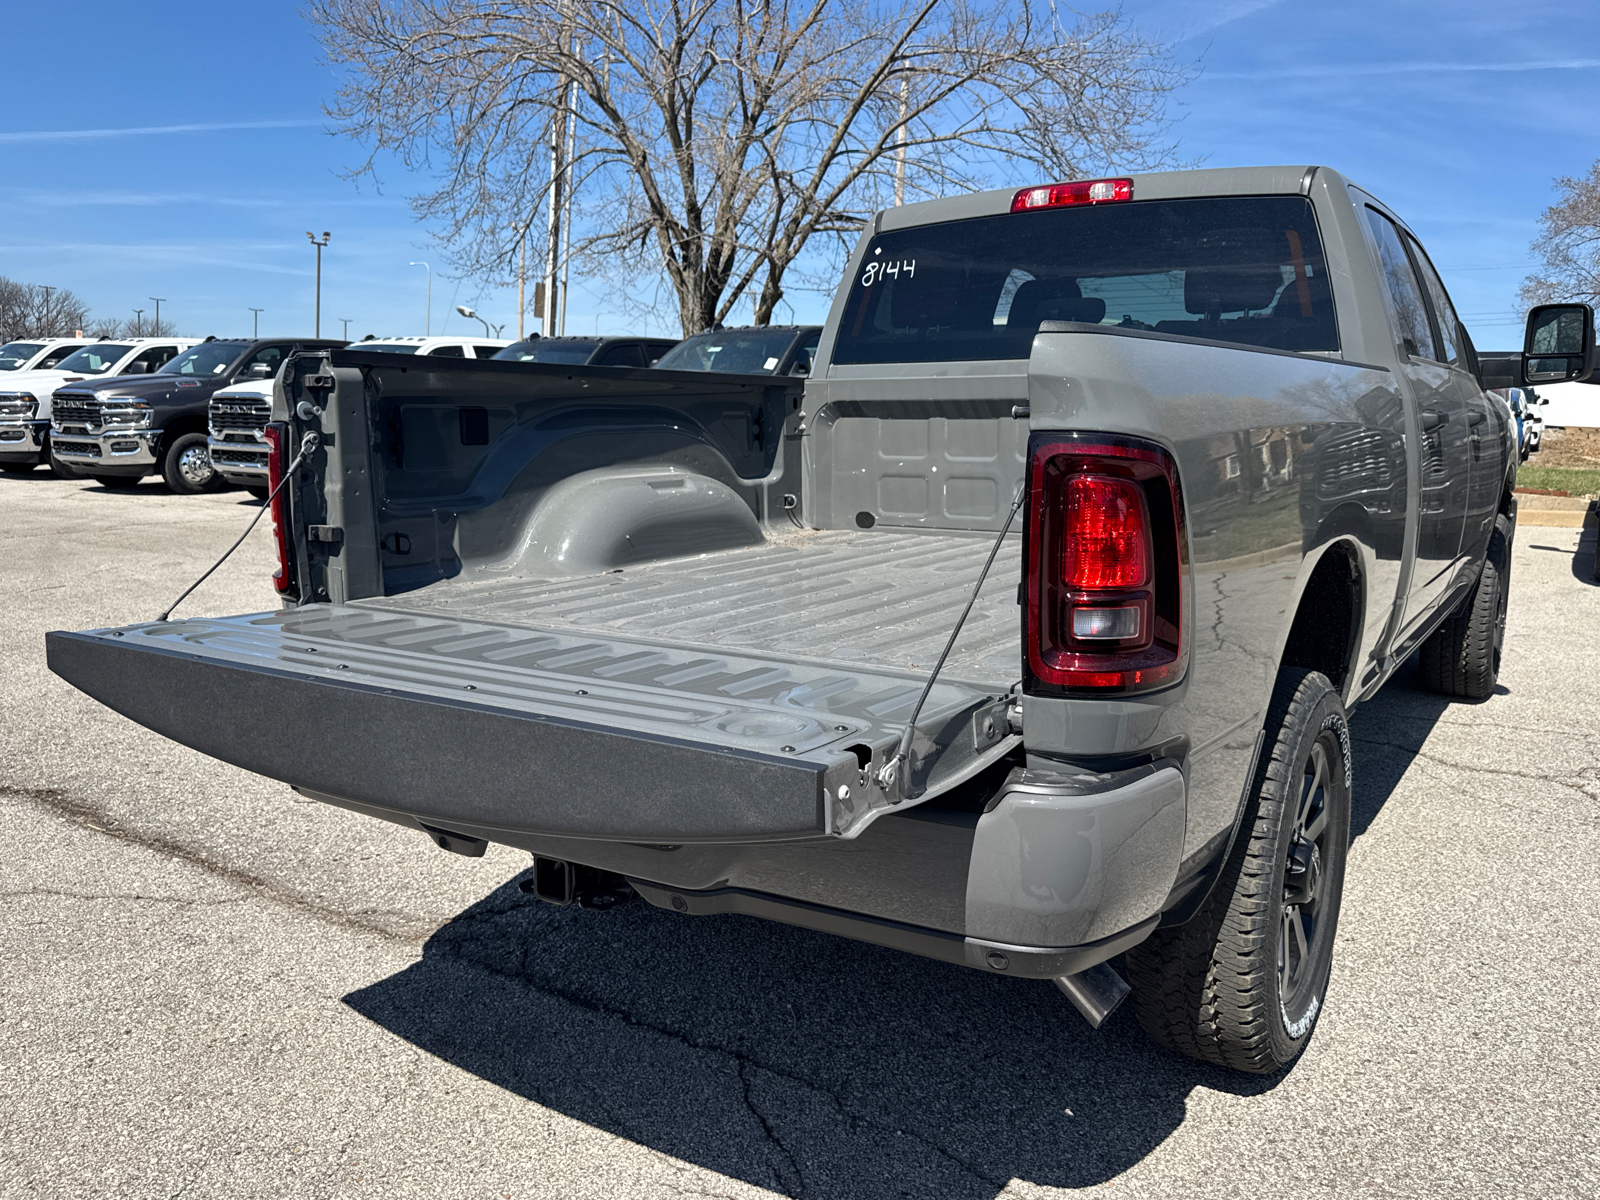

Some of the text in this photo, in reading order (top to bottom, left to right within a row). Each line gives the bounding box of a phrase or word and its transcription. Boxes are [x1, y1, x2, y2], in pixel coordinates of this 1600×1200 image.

[862, 259, 915, 287] 8144
[59, 400, 86, 409] RAM
[219, 404, 254, 414] RAM
